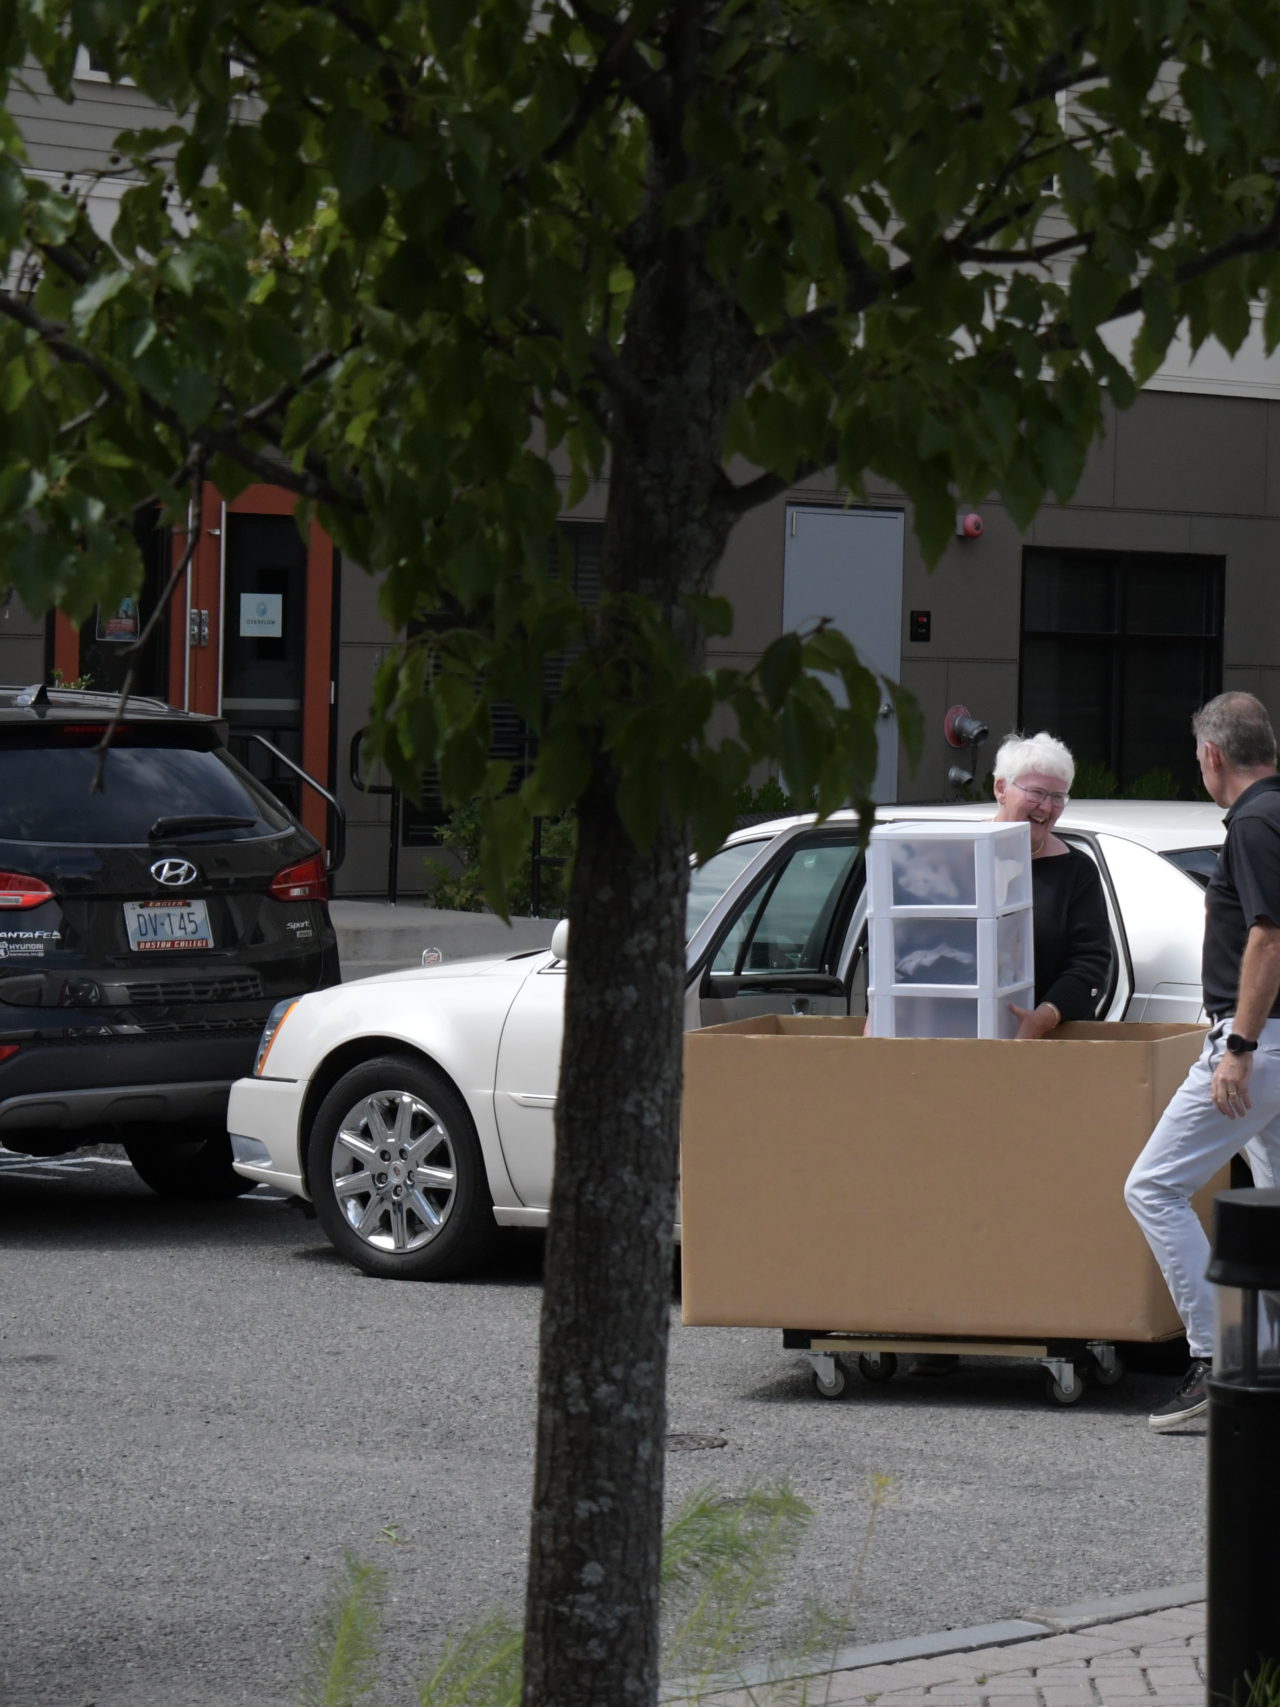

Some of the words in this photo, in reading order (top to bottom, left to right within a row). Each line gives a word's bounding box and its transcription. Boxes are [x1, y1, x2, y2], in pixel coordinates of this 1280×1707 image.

[136, 912, 198, 936] DV-145
[286, 920, 310, 930] Sport
[140, 940, 172, 949] BOSTON
[174, 940, 207, 948] COLLEGE
